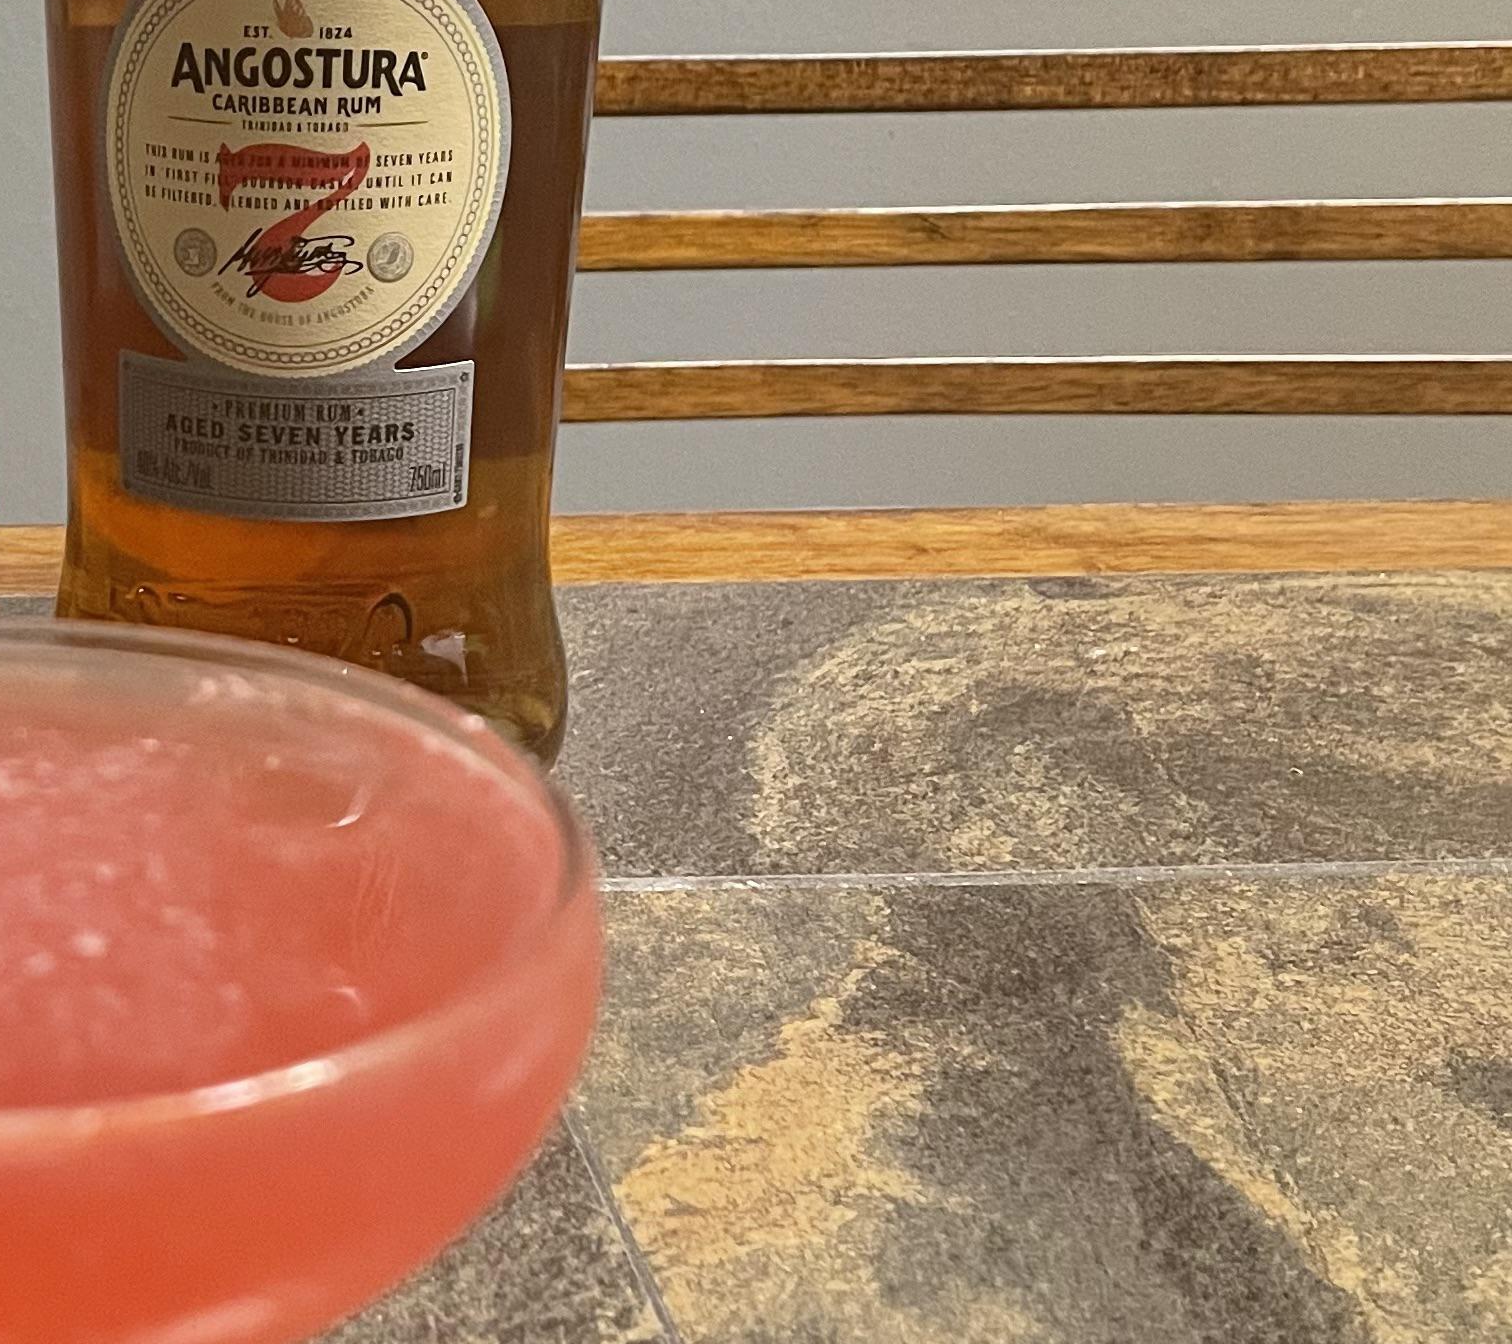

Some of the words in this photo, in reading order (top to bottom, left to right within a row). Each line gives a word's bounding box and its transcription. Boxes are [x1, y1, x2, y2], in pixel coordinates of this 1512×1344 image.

[243, 25, 273, 39] EST.
[319, 26, 353, 39] 1824
[171, 42, 426, 96] ANGOSTURA
[212, 93, 328, 116] CARIBBEAN
[337, 95, 381, 117] RUM
[242, 119, 292, 132] TRINIDAD
[307, 121, 349, 133] TOBAGO
[145, 143, 167, 158] THIS
[172, 147, 194, 162] RUM
[199, 151, 210, 164] IS
[295, 155, 349, 169] MINIMUM
[375, 153, 413, 168] SEVEN
[418, 149, 454, 164] YEARS
[144, 165, 156, 177] IN
[242, 175, 304, 190] BOURBON
[366, 175, 404, 189] UNTIL
[411, 173, 422, 186] IT
[430, 171, 453, 185] CAN
[145, 184, 156, 198] BE
[284, 198, 310, 211] AND
[318, 197, 373, 211] BOTTLED
[380, 195, 412, 210] WITH
[219, 142, 370, 303] 7
[225, 399, 305, 421] PREMIUM
[317, 404, 351, 422] RUM
[166, 413, 225, 439] AGED
[238, 423, 320, 446] SEVEN
[335, 422, 415, 446] YEARS
[174, 437, 231, 459] PRODUCT
[238, 447, 254, 460] OF
[261, 448, 327, 465] TRINIDAD
[335, 451, 344, 465] &
[352, 447, 404, 464] TOBAGO
[409, 463, 446, 493] 750ml
